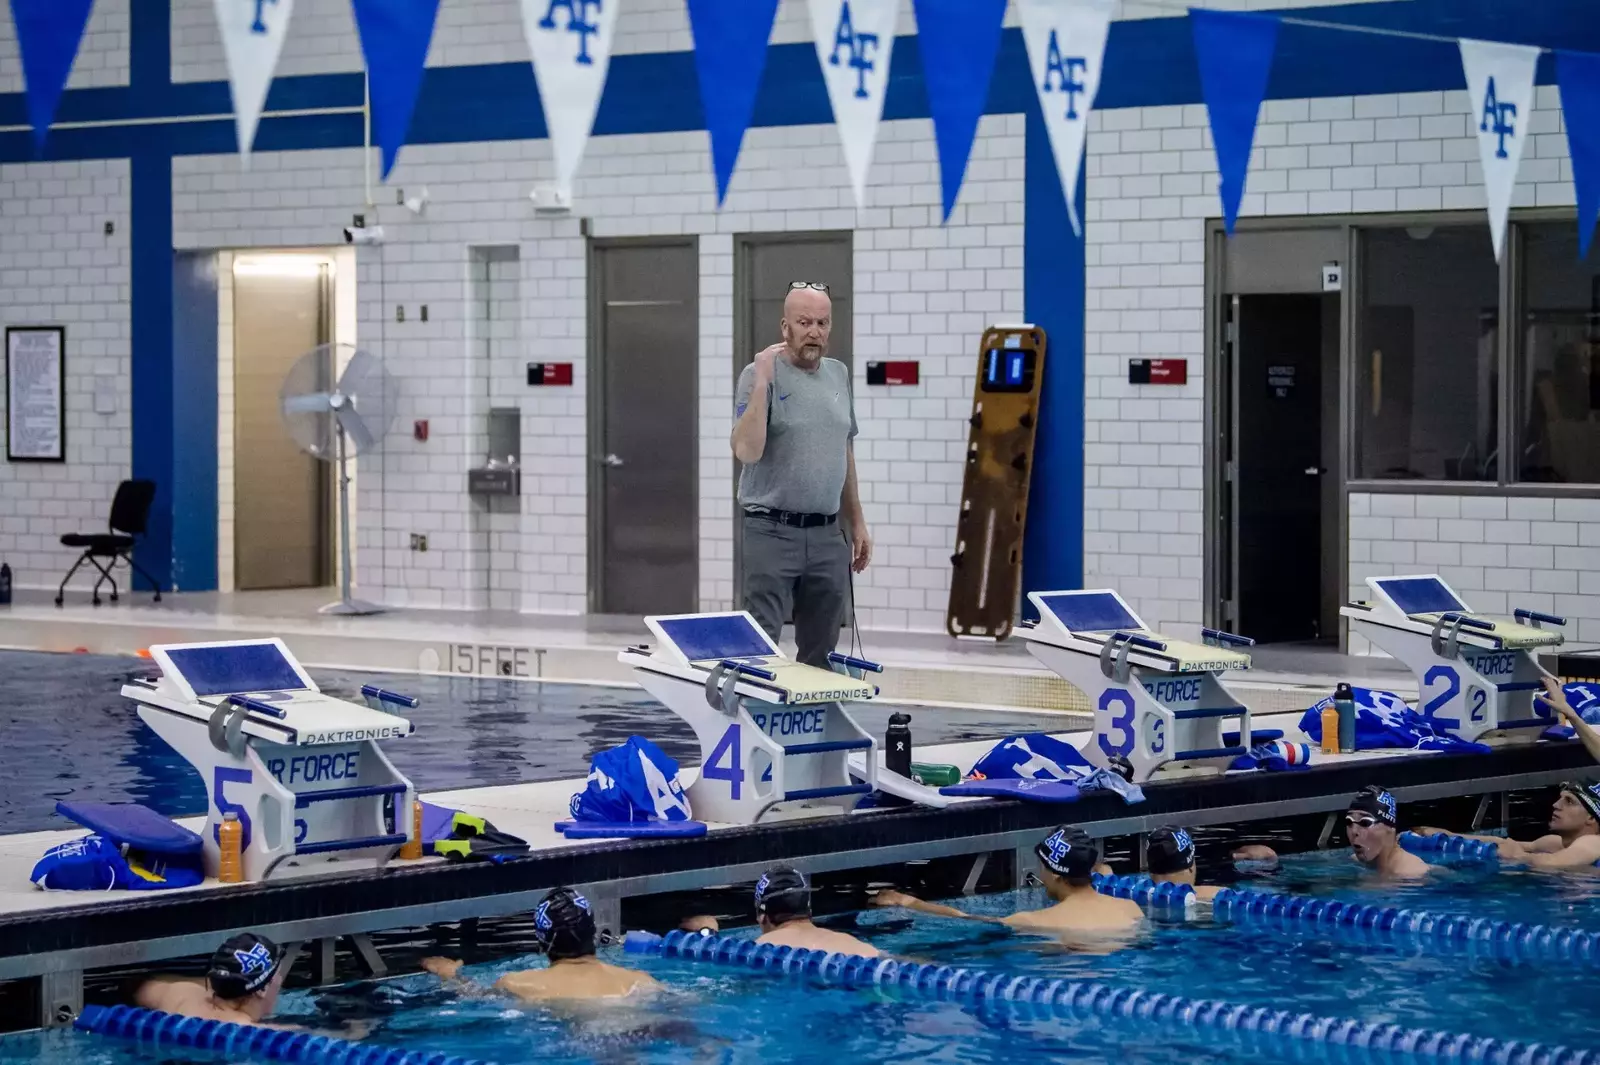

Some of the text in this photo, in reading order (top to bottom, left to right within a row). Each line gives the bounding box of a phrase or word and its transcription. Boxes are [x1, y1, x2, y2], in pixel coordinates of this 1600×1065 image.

[829, 0, 878, 98] AF
[1043, 29, 1087, 120] AF
[1480, 75, 1516, 158] AF
[1185, 660, 1244, 671] DAKTRONICS
[1475, 655, 1515, 675] FORCE
[795, 688, 869, 702] DAKTRONICS
[1156, 679, 1202, 703] FORCE
[1424, 665, 1460, 729] 2
[1471, 690, 1486, 721] 2
[306, 726, 400, 744] DAKTRONICS
[769, 709, 826, 736] FORCE
[1098, 688, 1135, 758] 3
[1151, 719, 1164, 753] 3
[289, 751, 360, 784] FORCE
[703, 724, 745, 800] 4
[213, 766, 253, 854] 5
[1044, 829, 1071, 863] AF
[233, 941, 273, 975] AF
